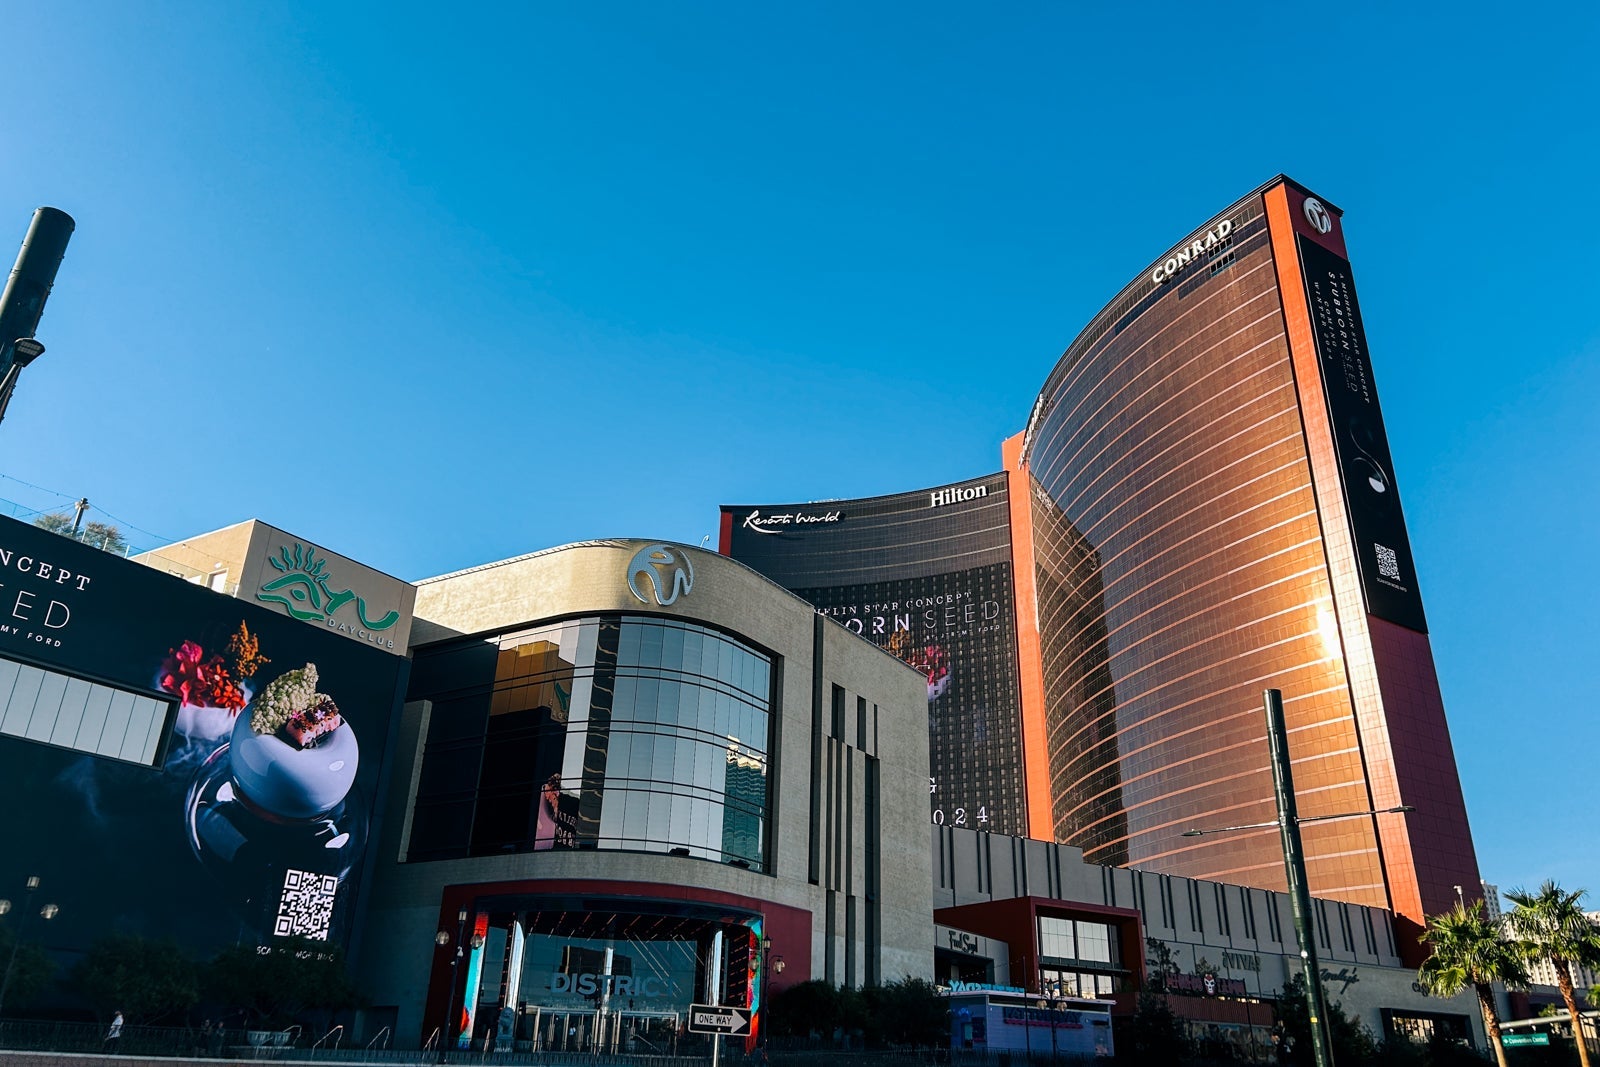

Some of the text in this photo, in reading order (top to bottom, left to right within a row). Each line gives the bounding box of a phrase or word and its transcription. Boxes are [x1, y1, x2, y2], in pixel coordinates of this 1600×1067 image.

[1151, 219, 1232, 283] CONRAD
[1328, 271, 1350, 350] STUBBORN
[1344, 353, 1358, 392] SEED
[930, 485, 987, 508] Hilton
[742, 510, 840, 534] Resorts World
[0, 583, 71, 629] ED
[864, 602, 899, 613] STAR
[924, 600, 1000, 629] SEED
[27, 632, 62, 647] FORD
[327, 618, 395, 649] DAYCLUB
[256, 945, 272, 956] SCA
[549, 971, 673, 999] DISTRIC
[699, 1014, 732, 1025] ONE WAY
